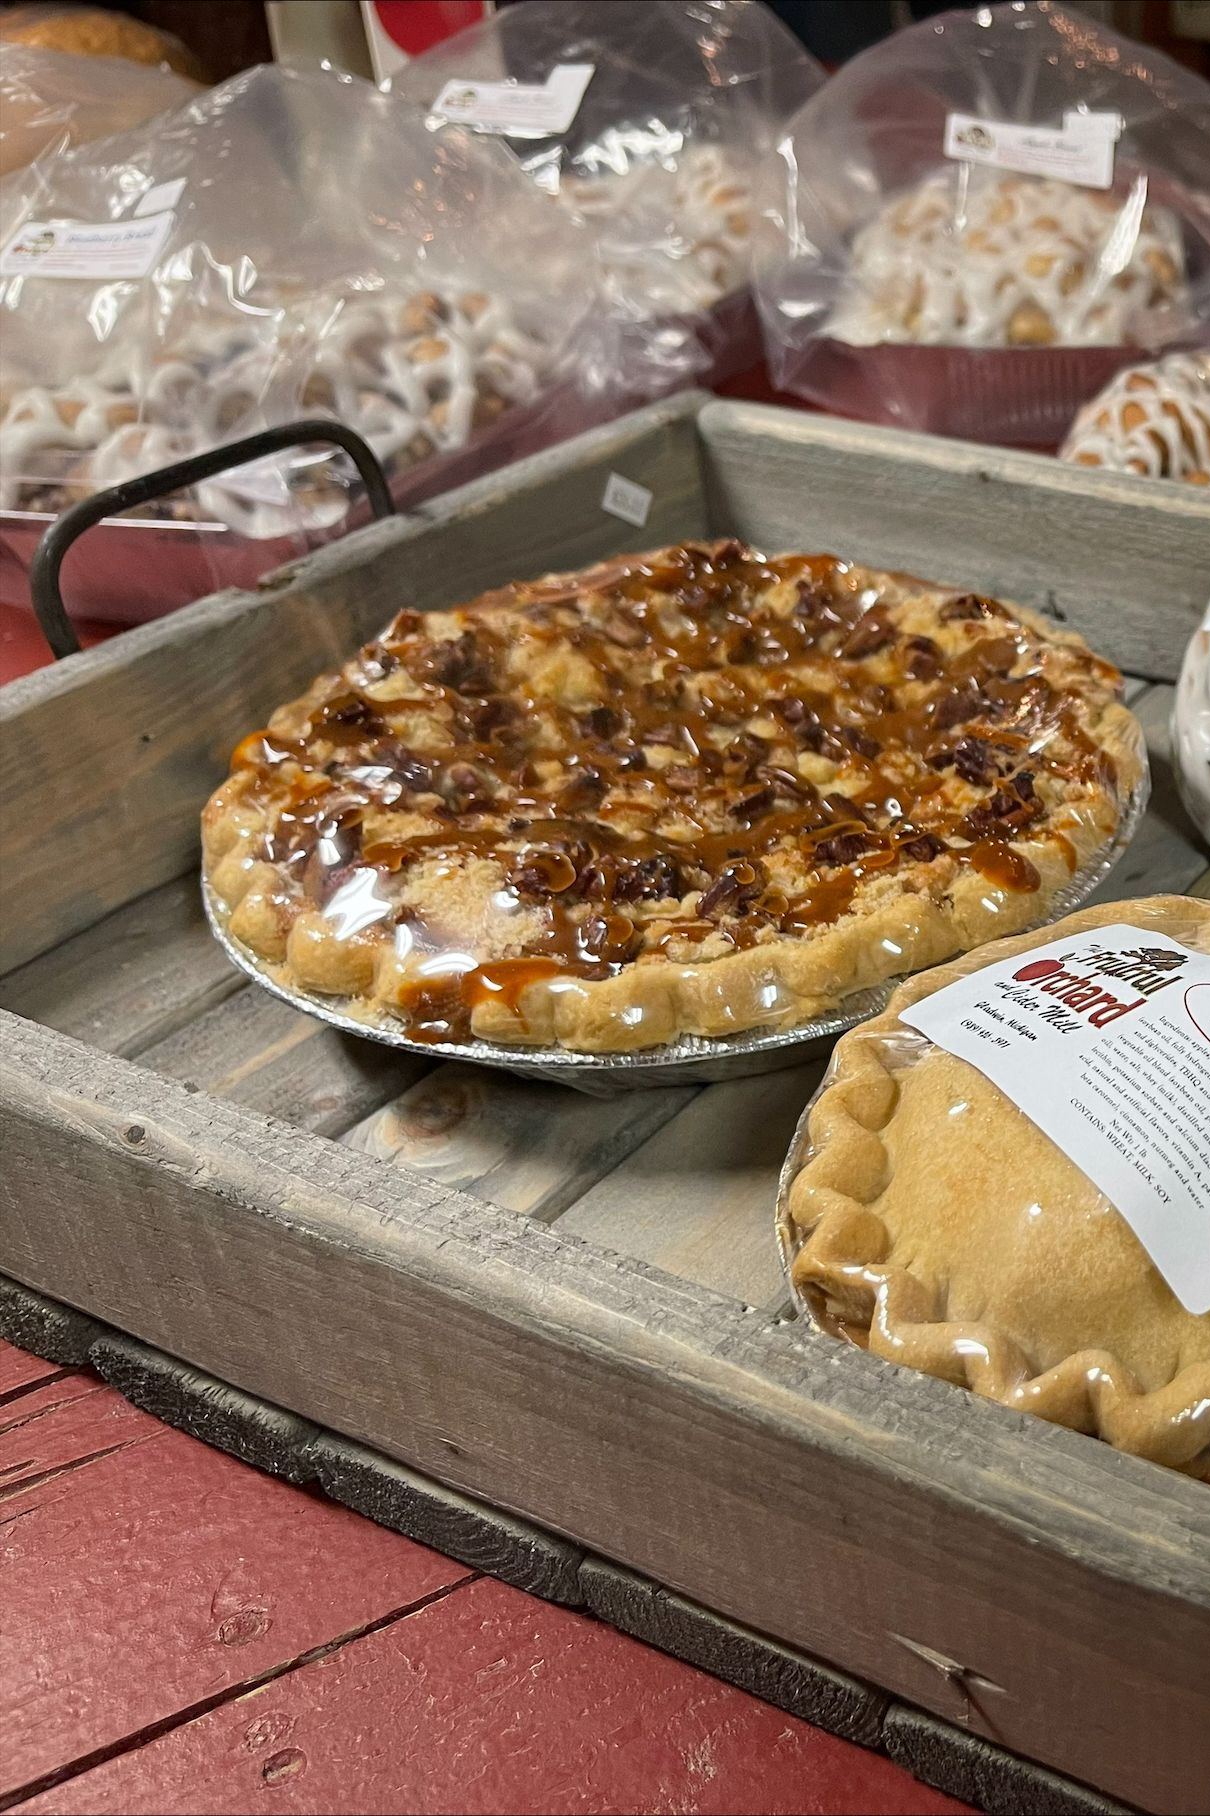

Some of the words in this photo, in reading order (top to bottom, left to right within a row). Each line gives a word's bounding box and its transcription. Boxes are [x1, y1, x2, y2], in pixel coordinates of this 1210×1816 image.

[1012, 959, 1148, 1029] Orchard
[1077, 950, 1184, 997] Fruitful
[1001, 988, 1040, 1012] Cider
[1038, 1005, 1083, 1034] Mill
[1134, 1031, 1148, 1040] and
[1179, 1066, 1201, 1087] TBHQ
[1143, 1055, 1155, 1063] oil
[1151, 1060, 1171, 1077] blend
[1171, 1041, 1185, 1054] fully
[1191, 1042, 1210, 1060] apples,
[1092, 1066, 1115, 1084] natural
[1112, 1083, 1126, 1094] and
[1123, 1094, 1151, 1118] artificial
[1171, 1141, 1195, 1170] vitamin
[1112, 1066, 1142, 1091] potassium
[1141, 1091, 1163, 1111] sorbate
[1163, 1112, 1178, 1124] and
[1175, 1125, 1199, 1152] calcium
[1142, 1071, 1157, 1086] whey
[1157, 1084, 1178, 1106] (milk),
[1177, 1106, 1205, 1133] distilled
[1080, 1072, 1093, 1085] beta
[1119, 1111, 1149, 1143] cinnamon,
[1151, 1142, 1175, 1169] nutmeg
[1174, 1170, 1189, 1185] and
[1187, 1185, 1204, 1209] water
[1109, 1119, 1122, 1132] Net
[1138, 1148, 1147, 1158] lb
[1106, 1131, 1134, 1162] WHEAT,
[1133, 1160, 1154, 1185] MILK,
[1154, 1185, 1171, 1203] SOY
